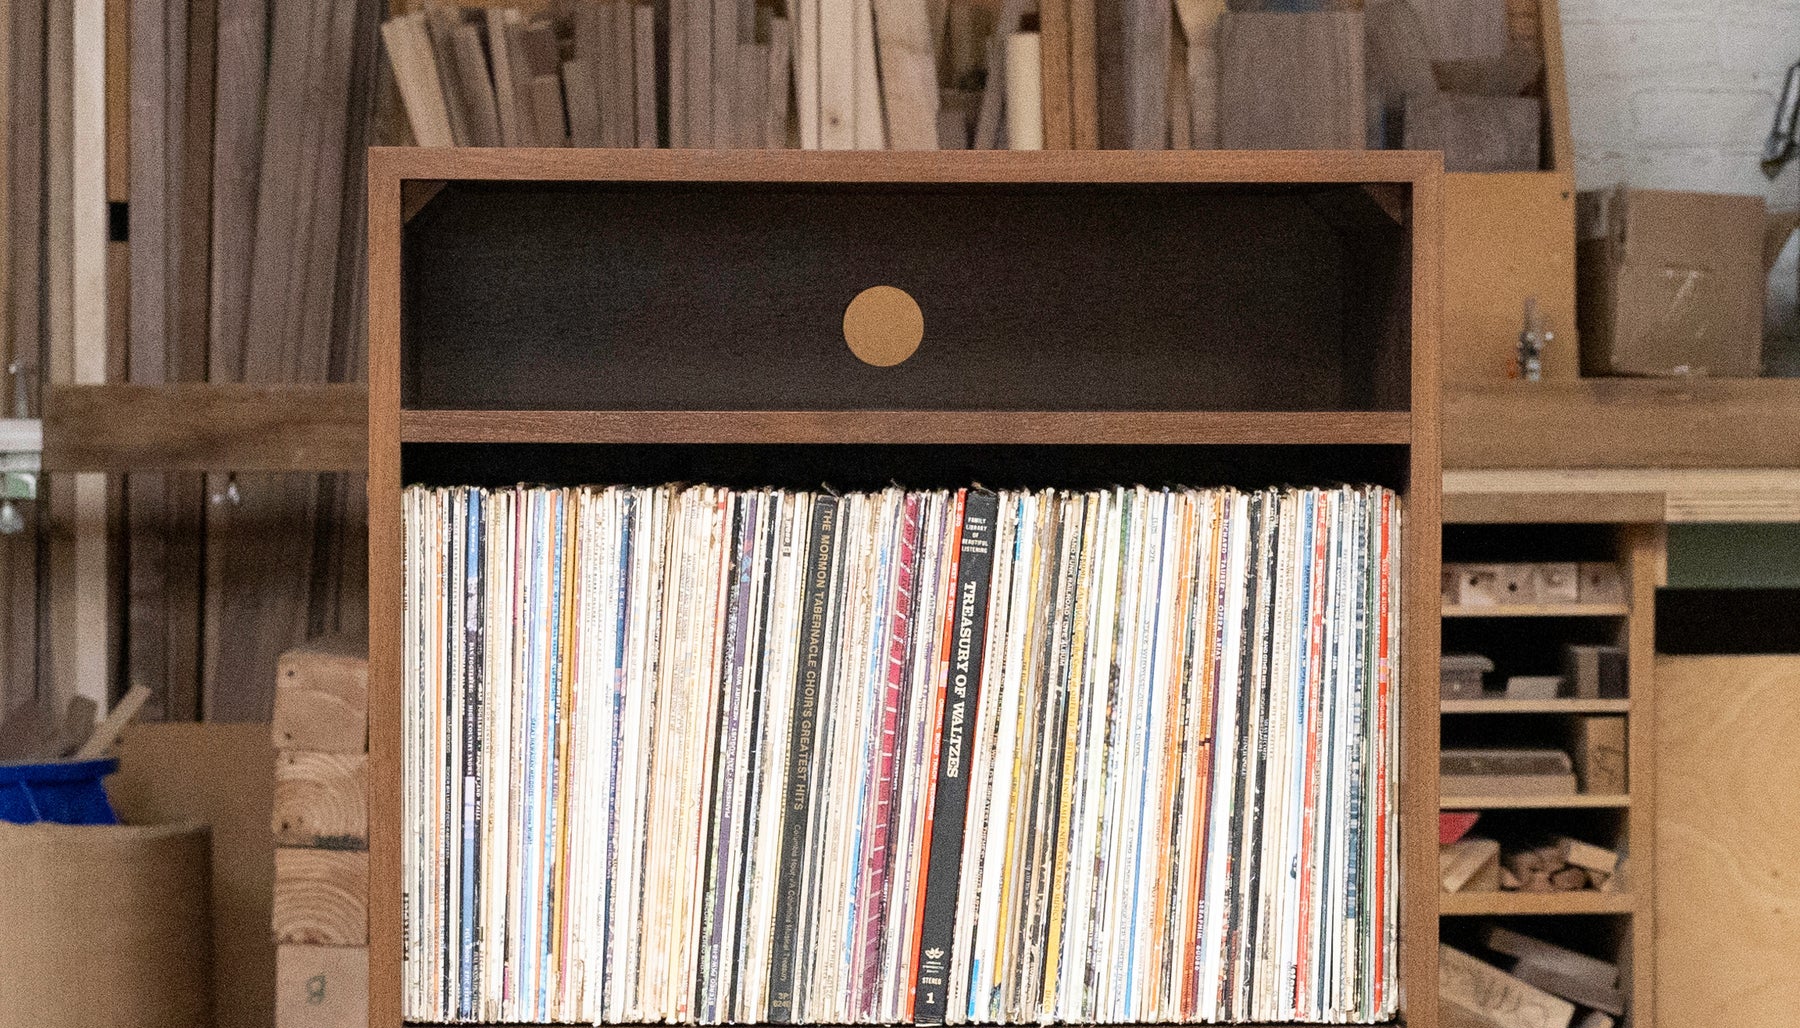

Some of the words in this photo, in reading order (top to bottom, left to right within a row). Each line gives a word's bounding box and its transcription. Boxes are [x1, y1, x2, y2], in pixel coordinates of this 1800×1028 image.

[822, 509, 832, 531] THE
[816, 534, 830, 588] MORMON
[1067, 555, 1076, 574] FUNK
[1063, 577, 1073, 614] RAILROAD
[808, 591, 824, 667] TABERNACLE
[956, 581, 976, 673] TREASURY
[1061, 620, 1069, 636] LIVE
[1058, 639, 1067, 666] ALBUM
[803, 671, 816, 717] CHOIR'S
[954, 674, 967, 698] OF
[733, 686, 741, 720] MERCURY
[935, 698, 944, 729] ORIGINAL
[730, 727, 738, 755] AUGUST
[797, 720, 811, 781] GREATEST
[933, 732, 941, 754] SOUND
[947, 701, 964, 778] WALTZES
[930, 758, 938, 779] TRACK
[724, 778, 733, 818] PIANISSIMO
[794, 784, 806, 810] HITS
[926, 782, 936, 820] RECORDING
[1060, 800, 1068, 824] JAMES
[791, 824, 801, 857] Columbia
[1056, 850, 1064, 870] YORK
[785, 890, 796, 923] Columbia
[1052, 893, 1061, 922] MUSICA
[783, 925, 793, 951] Musical
[780, 953, 791, 982] Treasury
[708, 978, 716, 1005] STEREO
[926, 992, 935, 1004] 1
